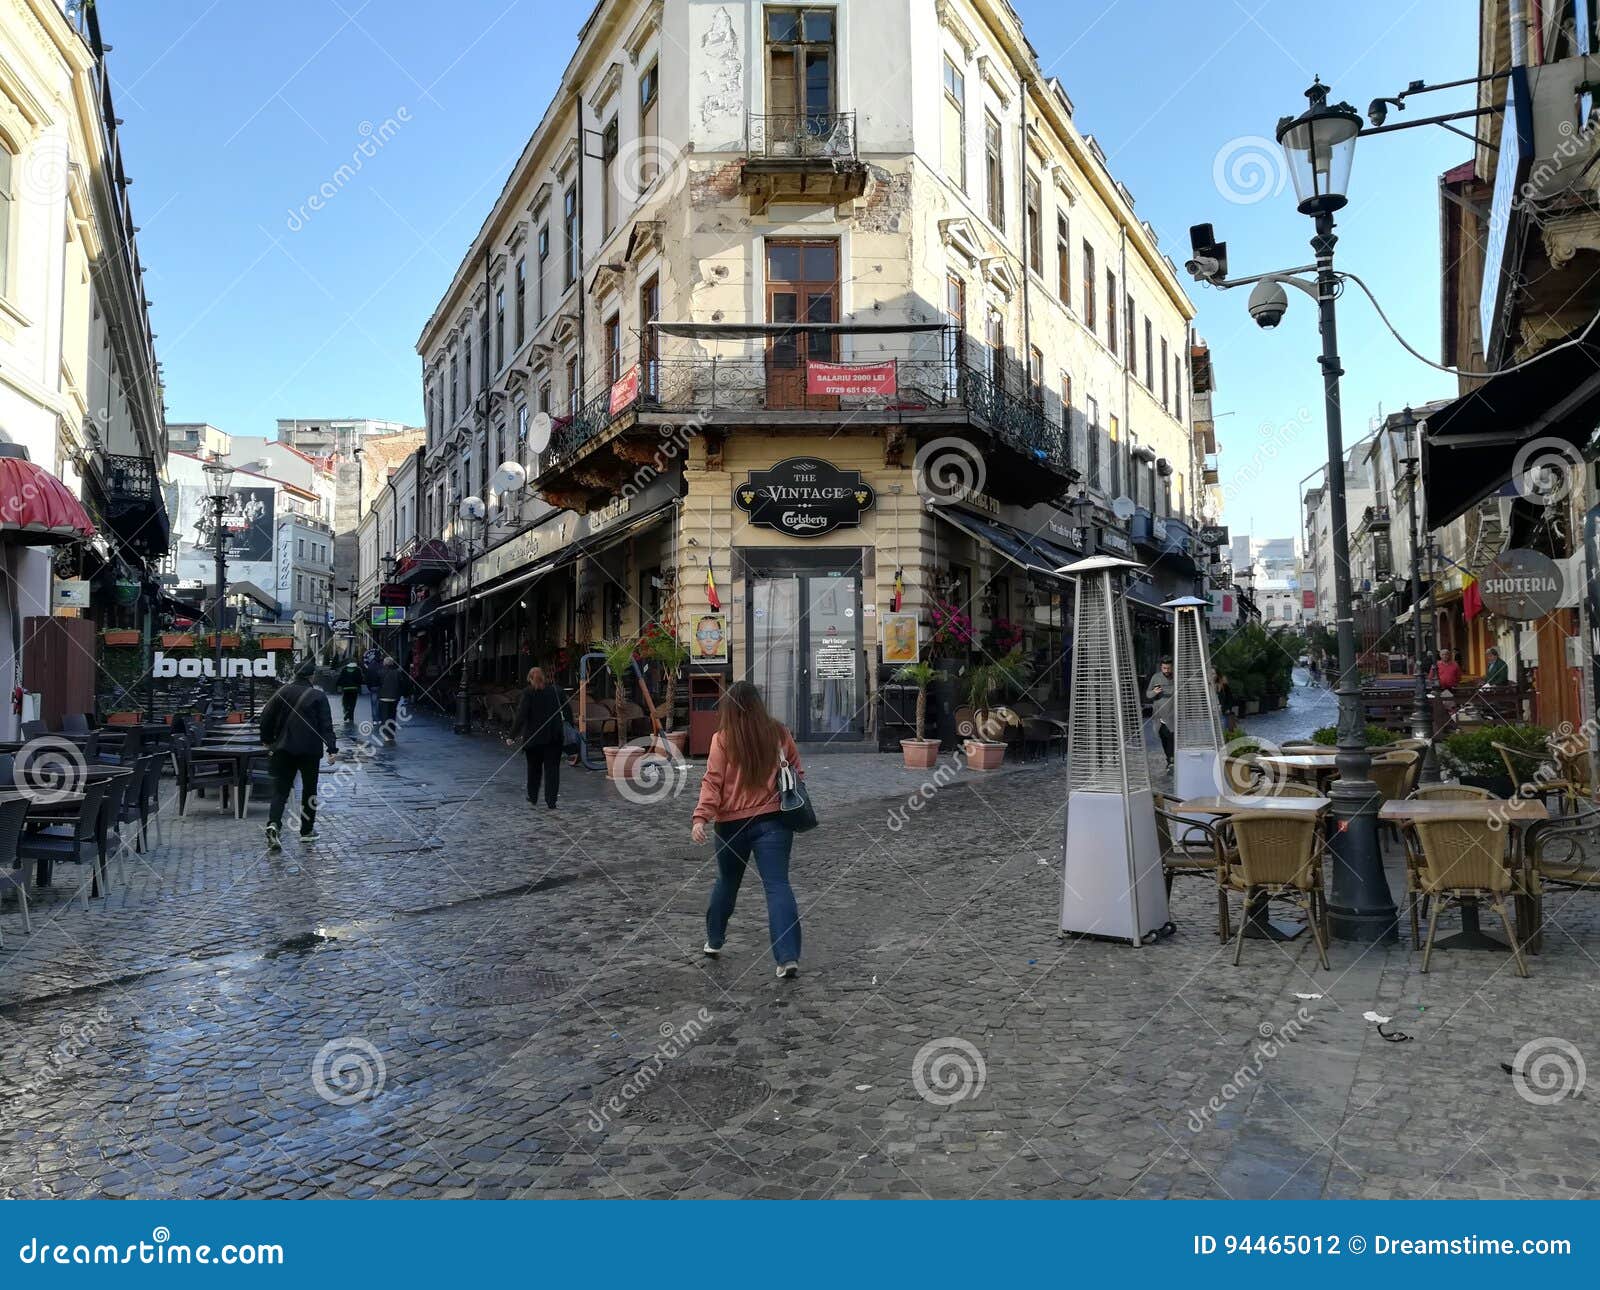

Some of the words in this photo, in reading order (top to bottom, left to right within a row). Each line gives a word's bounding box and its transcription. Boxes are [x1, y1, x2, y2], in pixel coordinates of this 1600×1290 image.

[793, 474, 817, 482] THE
[767, 485, 845, 502] VINTAGE
[782, 511, 828, 528] Carlsberg
[1485, 576, 1558, 594] SHOTERIA
[153, 651, 276, 678] bound
